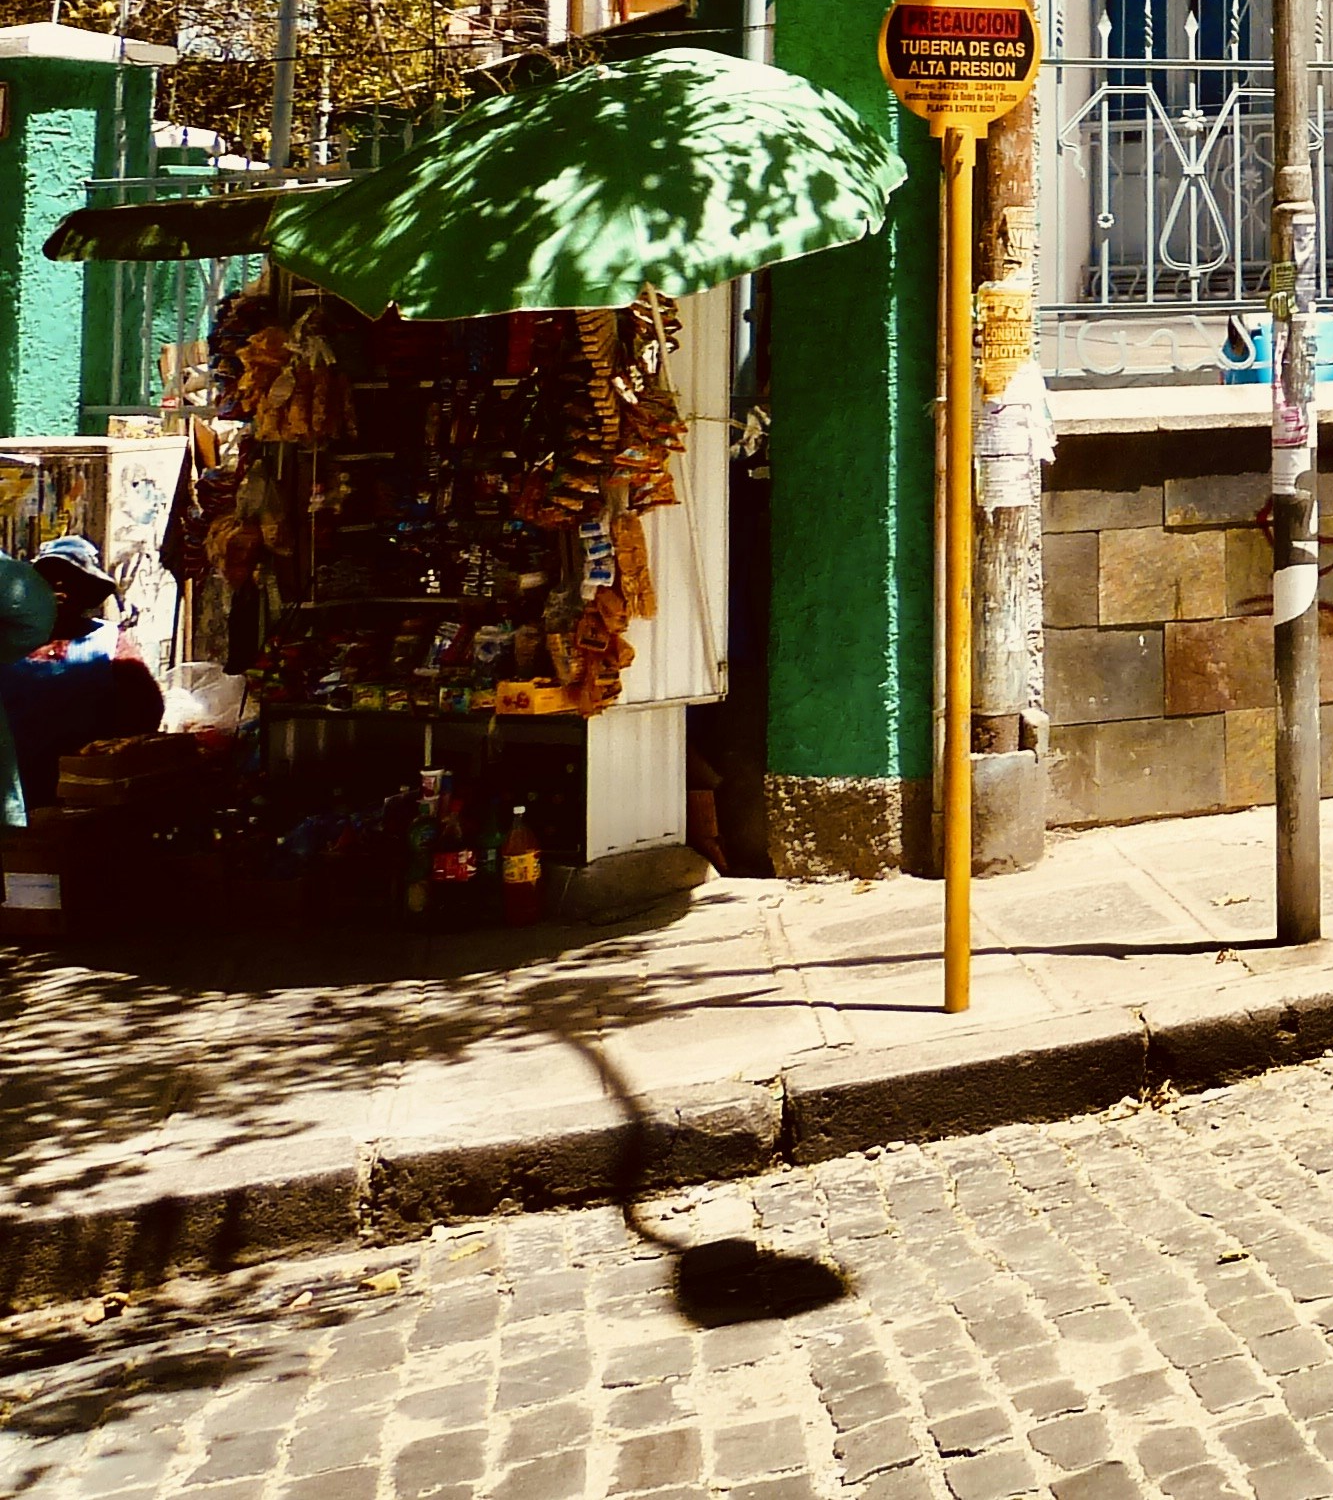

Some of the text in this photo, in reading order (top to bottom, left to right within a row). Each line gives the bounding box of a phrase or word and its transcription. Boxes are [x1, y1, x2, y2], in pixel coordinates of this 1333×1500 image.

[908, 10, 1017, 35] PRECAUCION
[901, 40, 1026, 57] TUBERIA DE GAS
[908, 60, 1016, 77] ALTA PRESION
